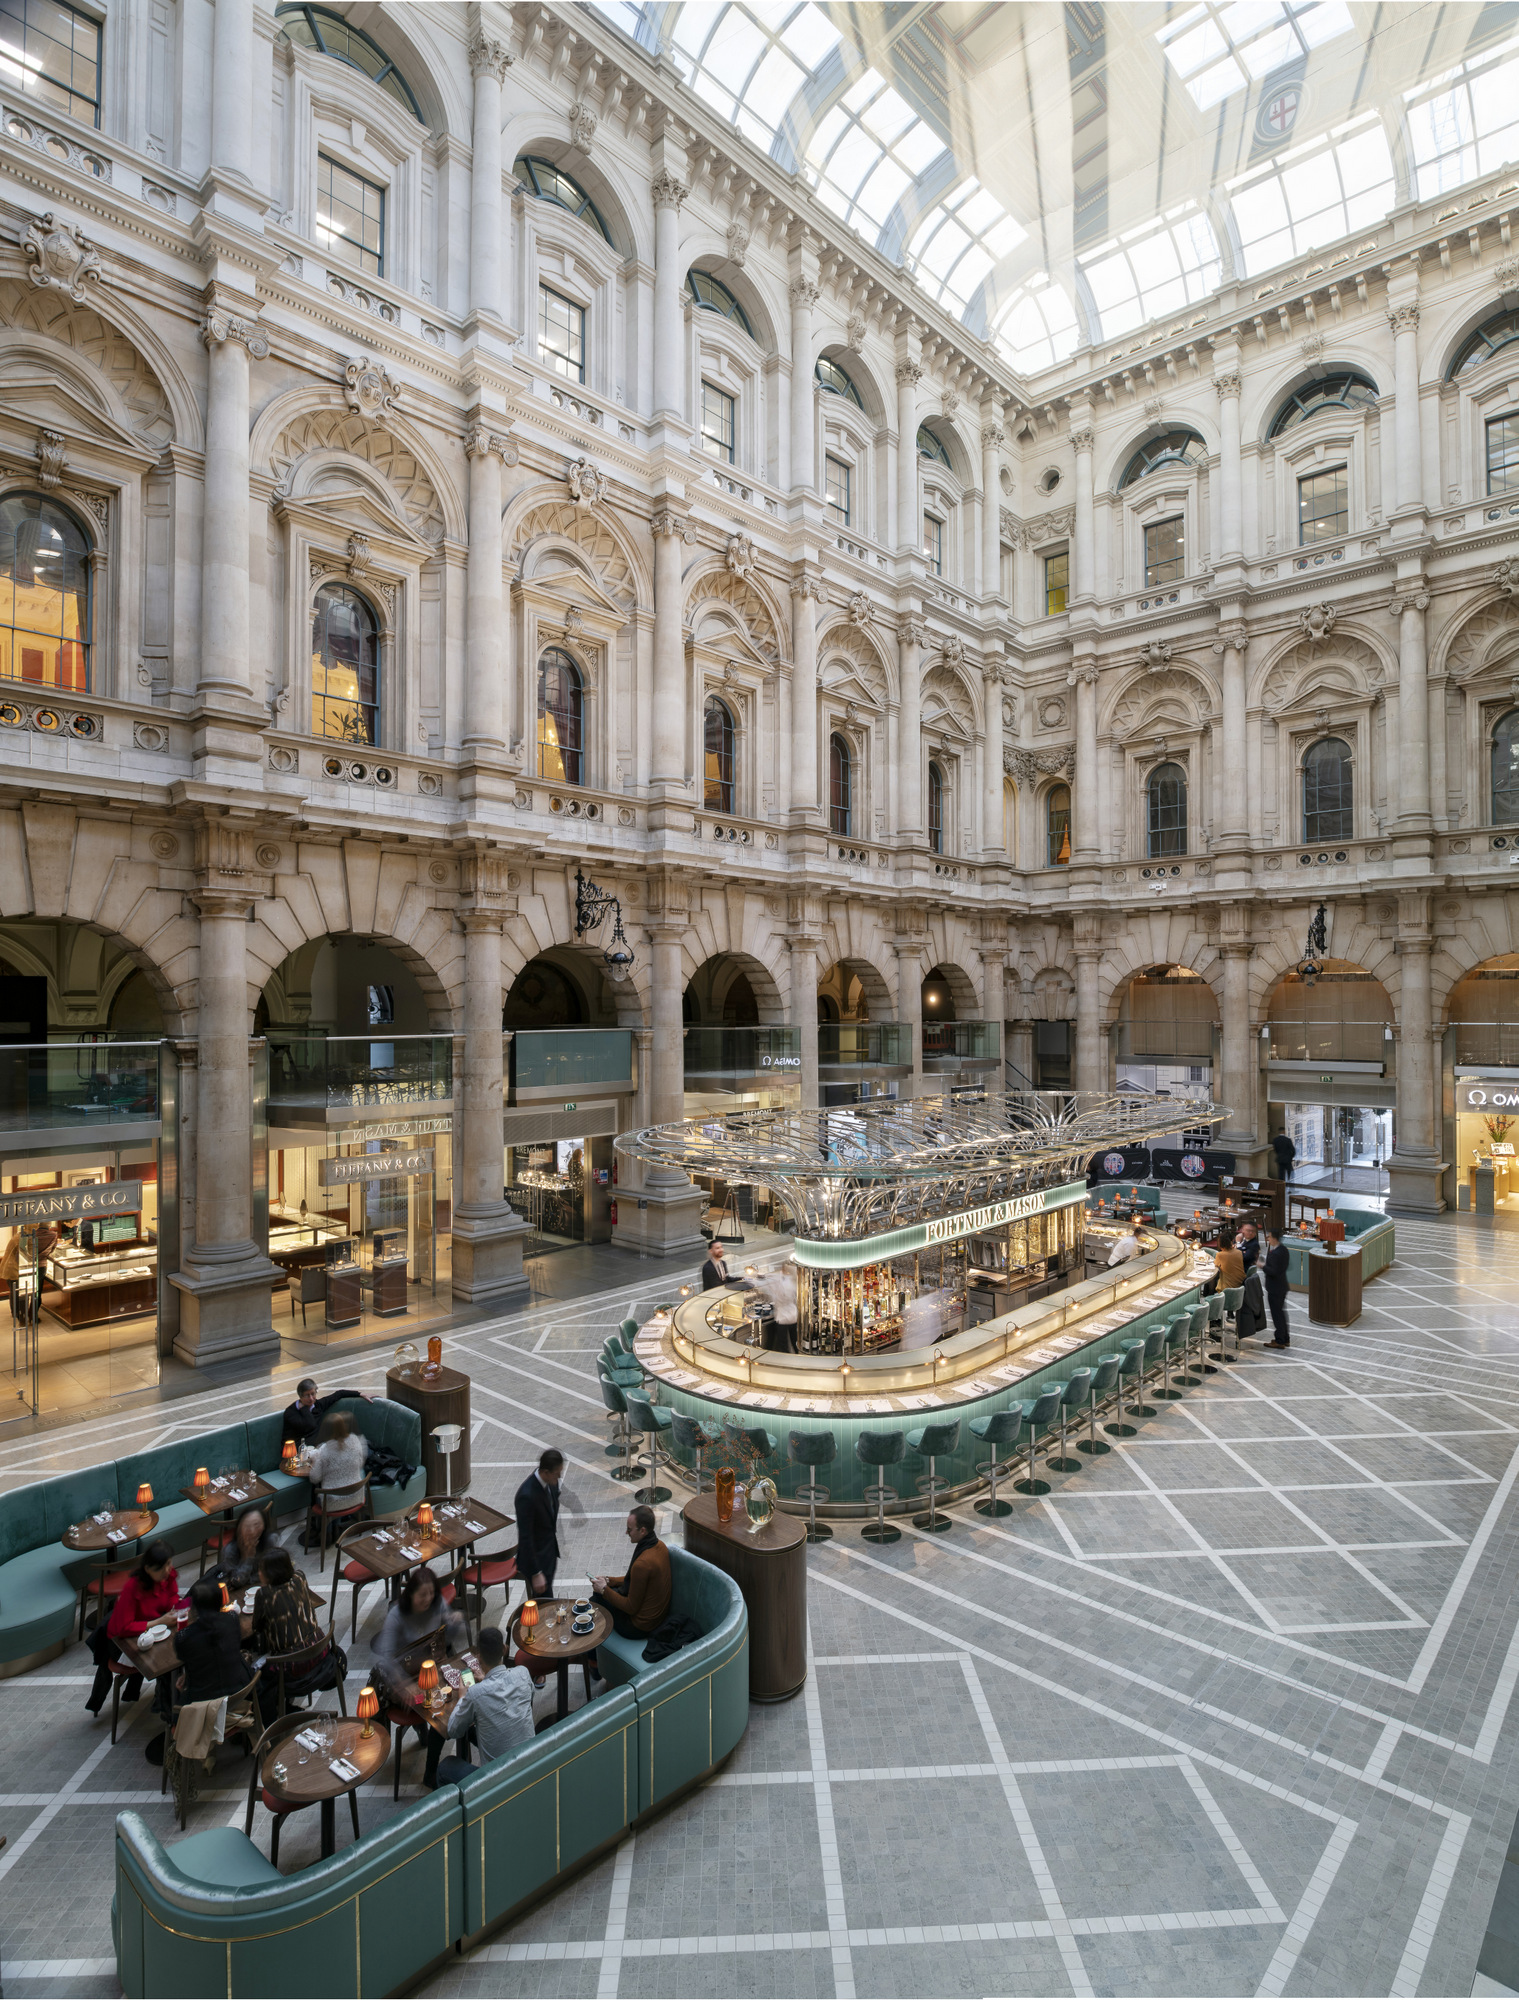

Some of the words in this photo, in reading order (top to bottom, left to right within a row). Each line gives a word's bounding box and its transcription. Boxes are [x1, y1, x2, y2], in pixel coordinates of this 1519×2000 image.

[334, 1160, 392, 1177] TIFFANY
[394, 1159, 403, 1170] &
[82, 1194, 96, 1210] &
[926, 1207, 993, 1241] FORTNUM
[994, 1205, 1005, 1222] &
[1006, 1193, 1046, 1219] MASON
